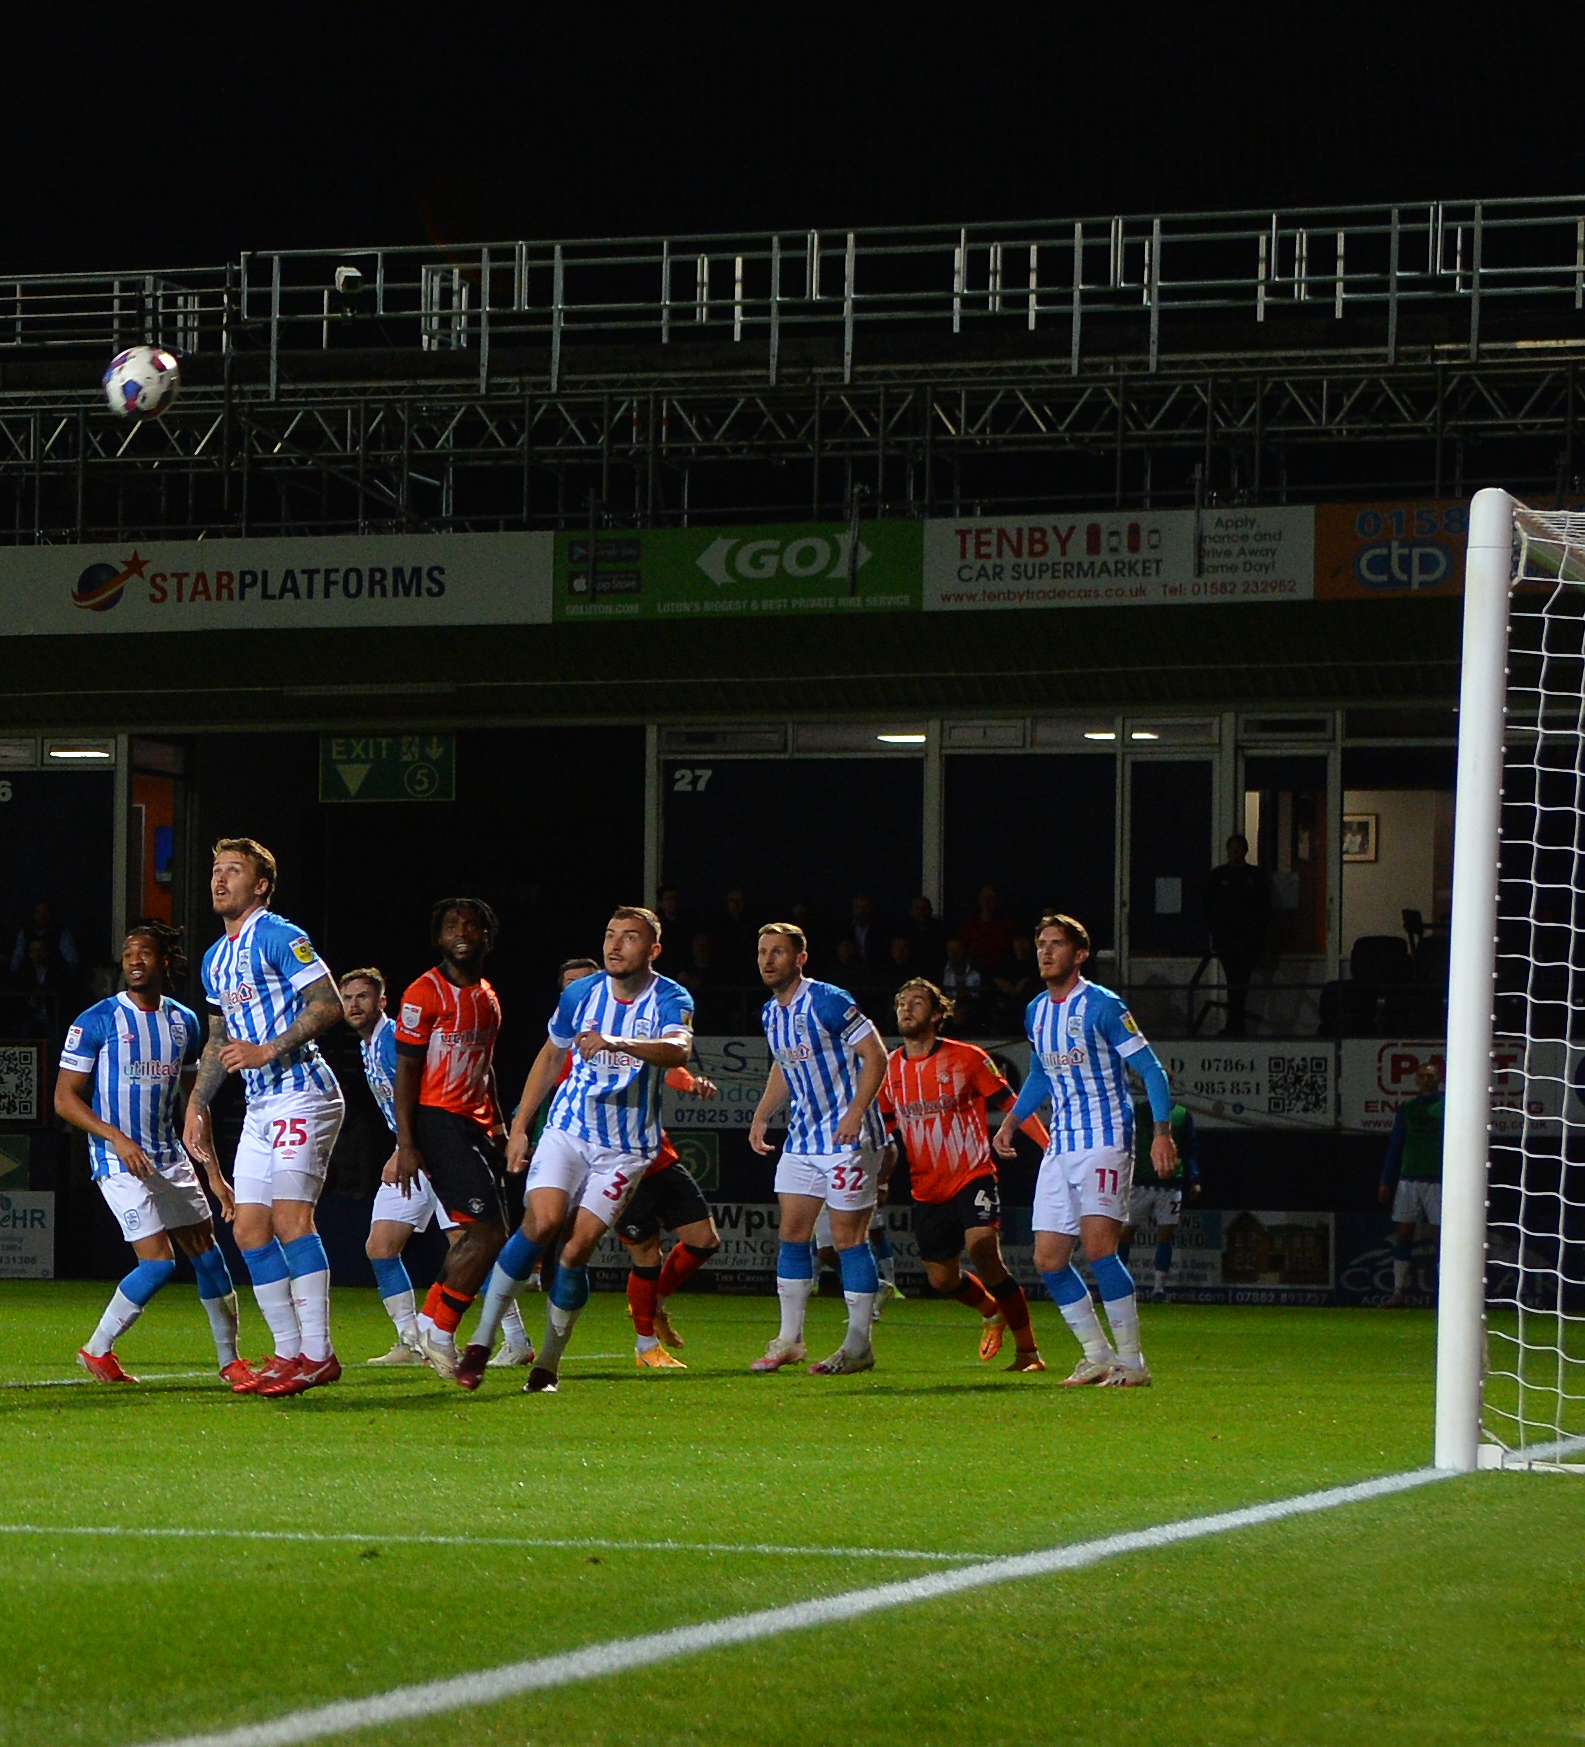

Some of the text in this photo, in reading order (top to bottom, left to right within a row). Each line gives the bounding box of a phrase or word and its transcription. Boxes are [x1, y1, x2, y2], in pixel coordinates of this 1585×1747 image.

[954, 525, 1076, 560] TENBY
[1254, 531, 1282, 542] and
[734, 536, 831, 579] GO
[1238, 547, 1278, 560] Away
[1359, 539, 1448, 591] ctp
[956, 559, 1164, 583] CAR SUPERMARKET
[1243, 561, 1276, 574] Day!
[149, 564, 446, 604] STARPLATFORMS
[940, 584, 1147, 604] www.tenbytradecars.co.uk
[1192, 581, 1237, 596] 01582
[1243, 579, 1297, 595] 232952
[331, 738, 393, 760] EXIT
[414, 769, 430, 791] 5
[673, 769, 713, 792] 27
[675, 1108, 729, 1124] 07825
[271, 1117, 307, 1149] 25
[831, 1166, 864, 1192] 32
[1094, 1167, 1119, 1196] 11
